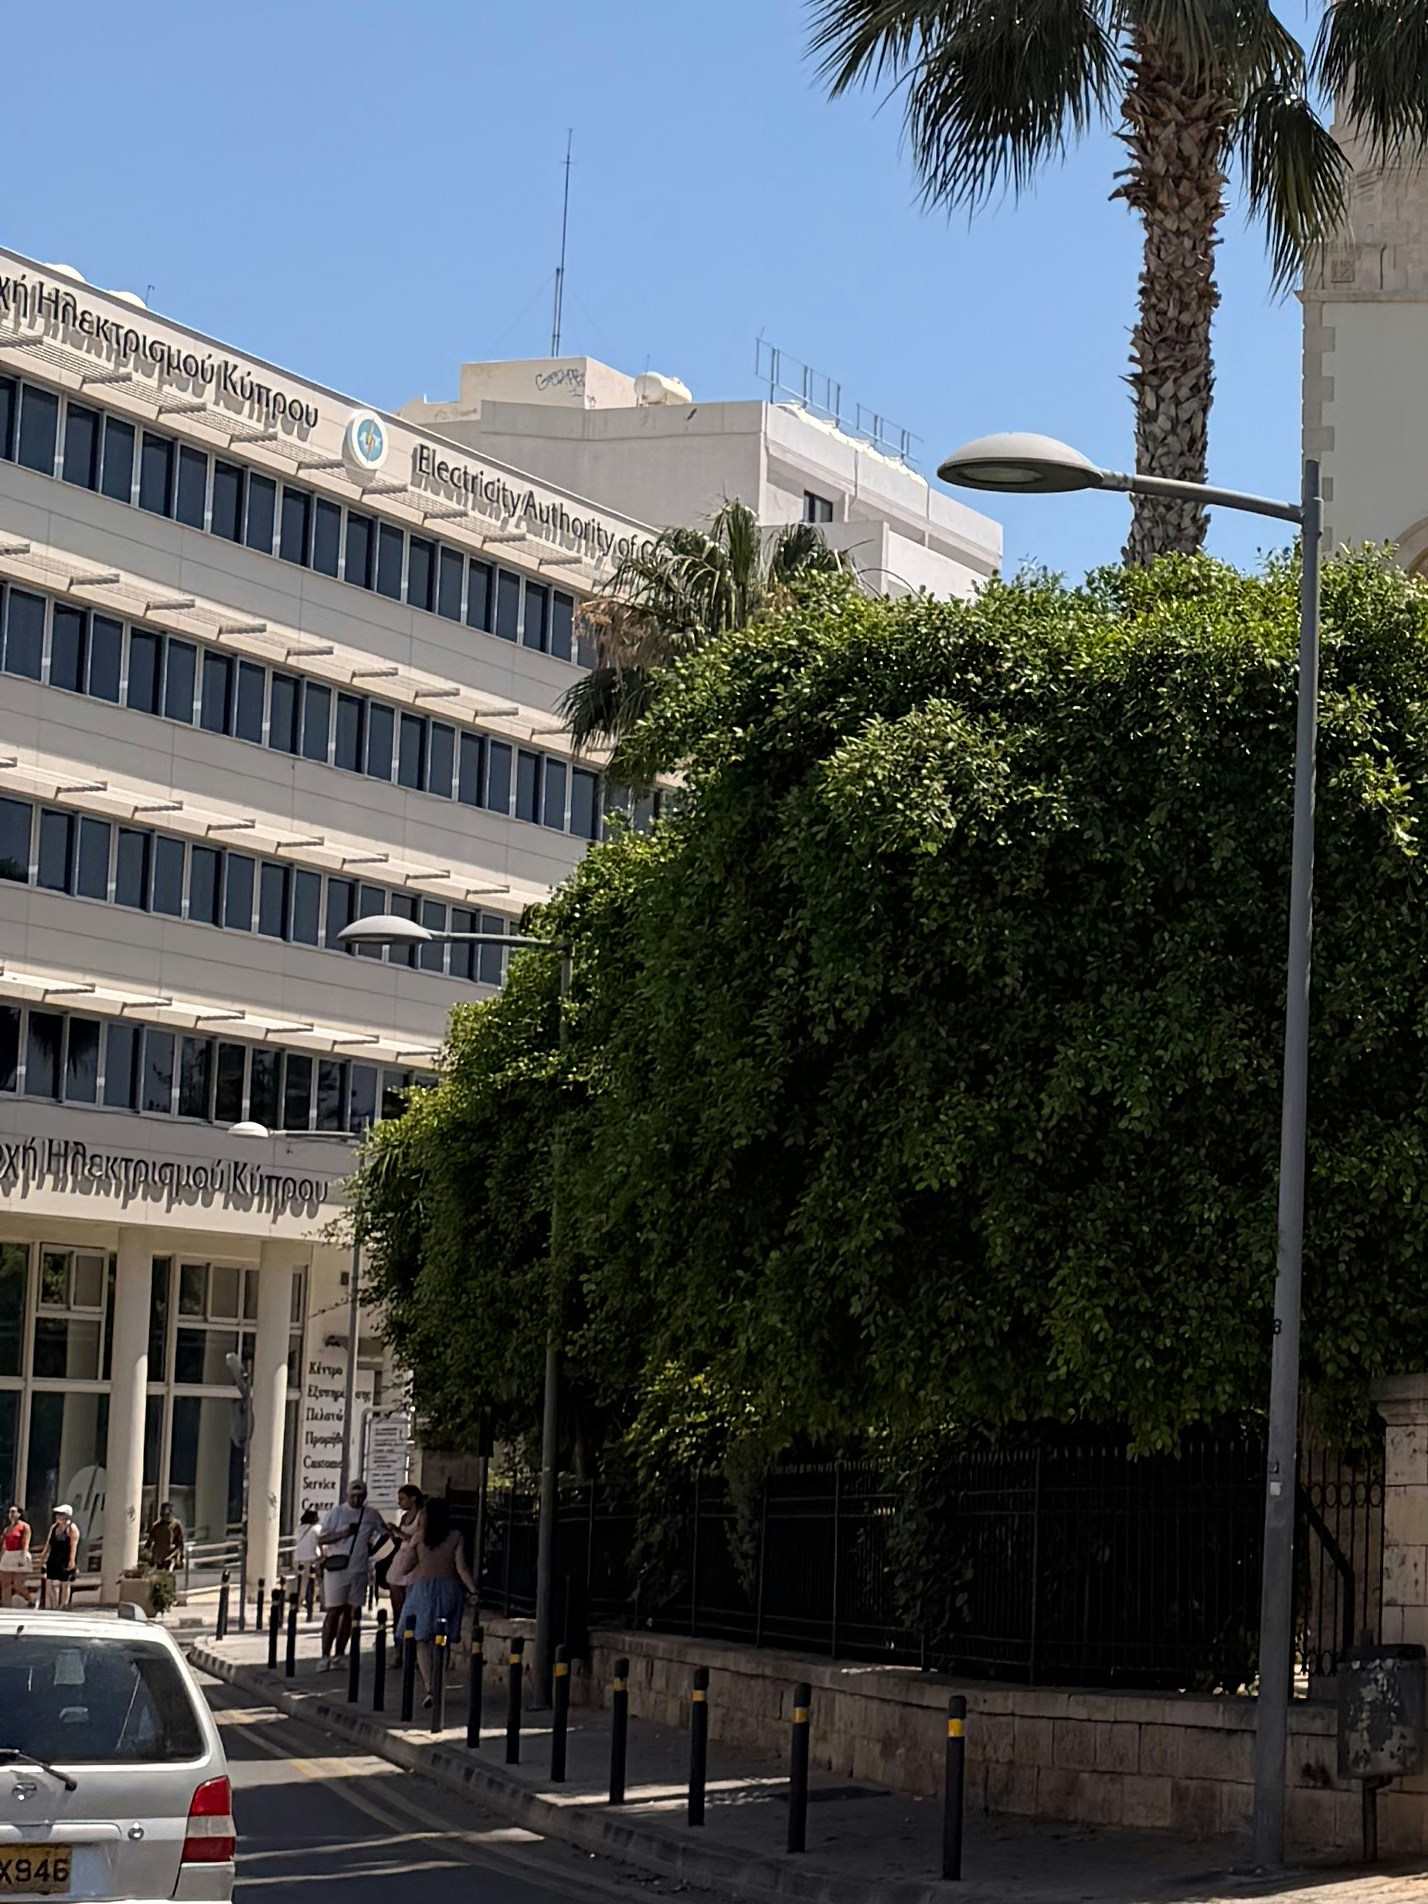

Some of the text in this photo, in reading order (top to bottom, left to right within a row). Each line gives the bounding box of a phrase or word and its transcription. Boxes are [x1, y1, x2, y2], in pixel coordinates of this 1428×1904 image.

[37, 280, 214, 384] Ηλεκτρισμού
[222, 359, 318, 428] Κύπρου
[418, 444, 522, 517] Electricity
[523, 490, 615, 557] Authority
[618, 533, 638, 558] of
[47, 1139, 223, 1196] Ηλεκτρισμού
[232, 1160, 328, 1203] Κύπρου
[303, 1477, 336, 1490] Service
